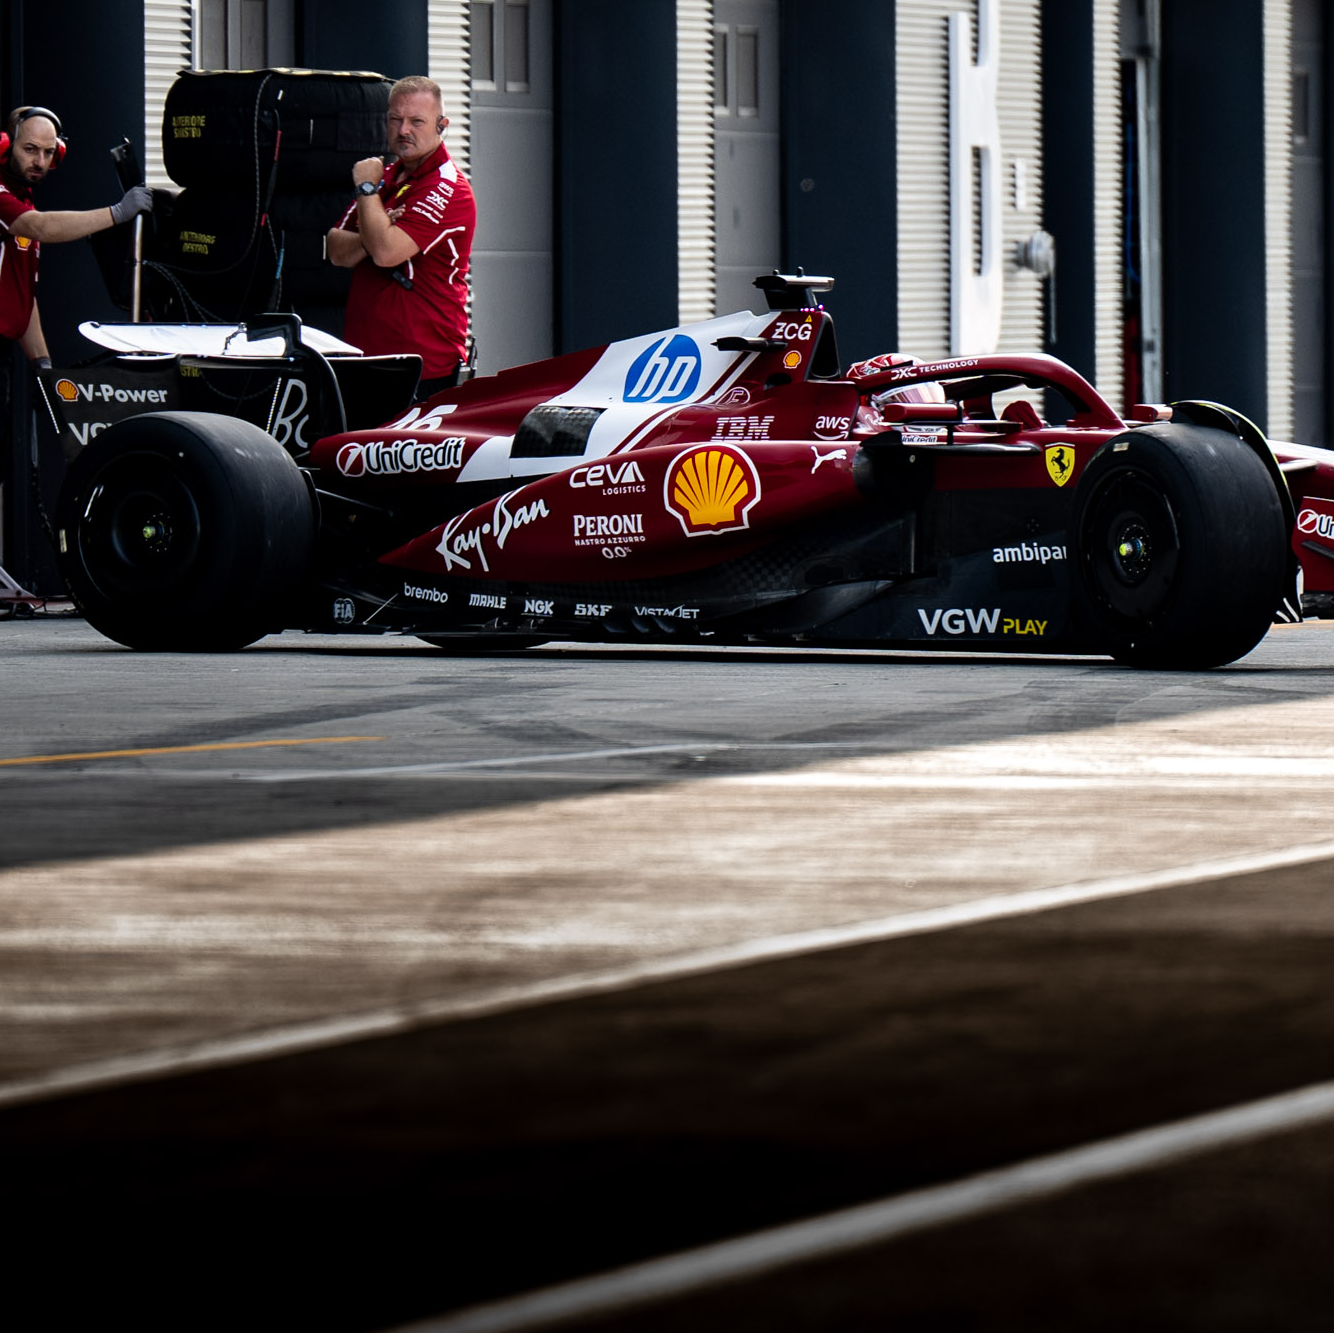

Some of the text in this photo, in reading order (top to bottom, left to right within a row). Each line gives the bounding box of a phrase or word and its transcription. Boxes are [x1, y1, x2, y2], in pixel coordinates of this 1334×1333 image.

[627, 334, 699, 404] hp
[919, 359, 979, 374] TECHNOLOGY
[77, 383, 167, 404] V-Power
[711, 416, 775, 442] IBM
[815, 416, 851, 430] aws
[365, 437, 467, 475] UniCredit
[602, 485, 647, 496] LOGISTICS
[573, 514, 644, 537] PERONI
[574, 535, 647, 546] NASTRO AZZURRO
[404, 582, 449, 604] brembo
[469, 593, 507, 610] MAHLE
[333, 603, 354, 619] FIA
[524, 599, 555, 615] NGK
[574, 603, 613, 617] SKF
[917, 608, 1049, 636] VGW PLAY
